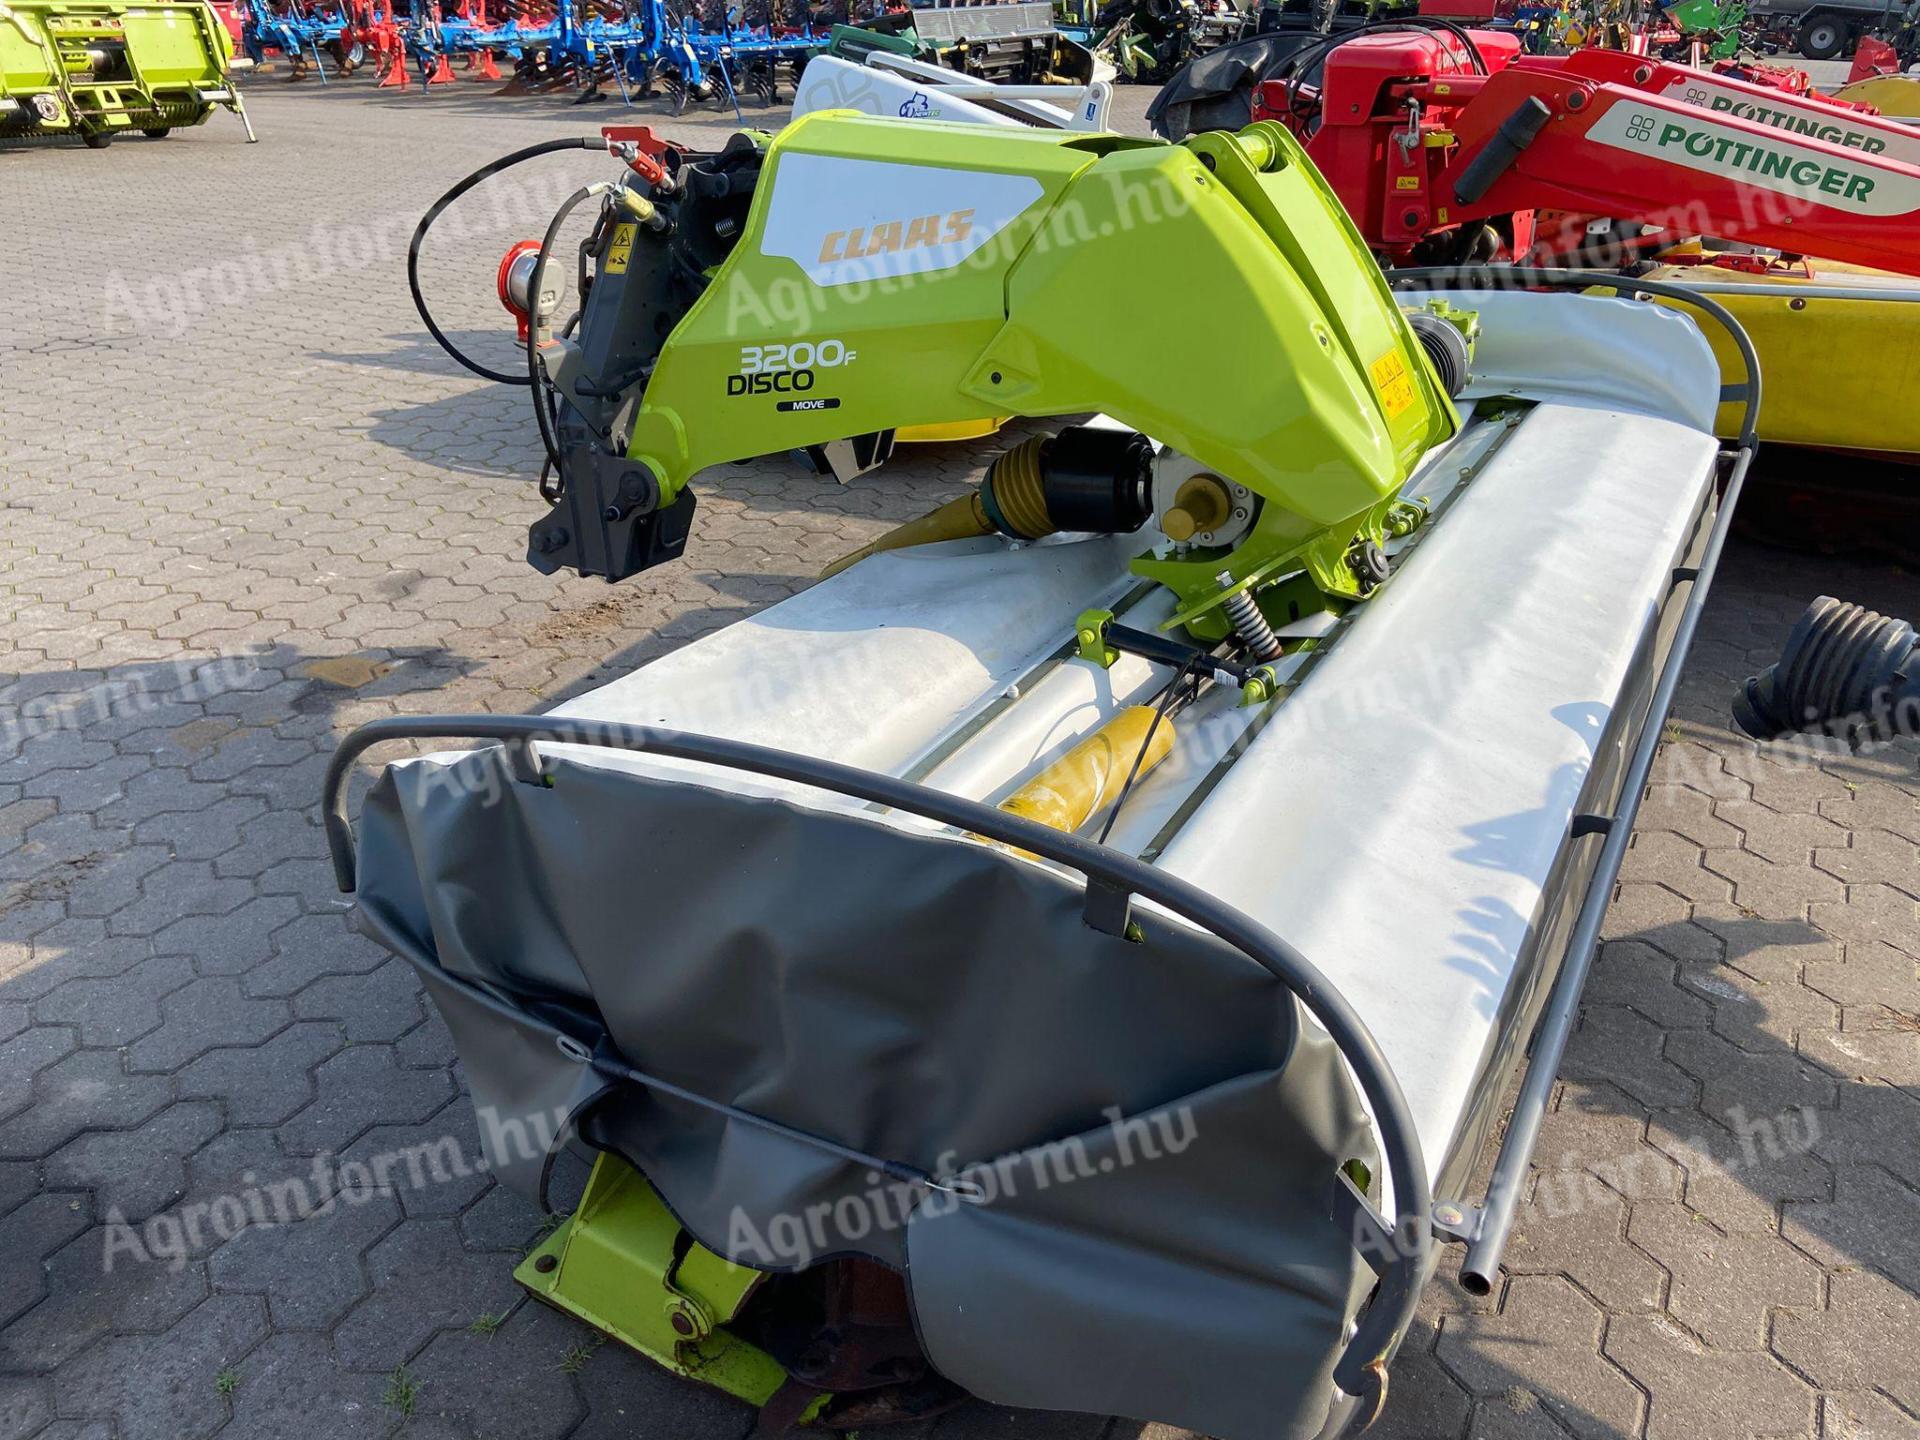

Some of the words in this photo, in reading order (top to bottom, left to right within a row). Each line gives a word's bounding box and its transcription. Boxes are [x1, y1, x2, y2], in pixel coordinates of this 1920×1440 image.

[1658, 123, 1875, 203] PÖTTINGER
[818, 208, 976, 263] CLAAS
[727, 369, 815, 396] DISCO
[792, 400, 825, 411] MOVE
